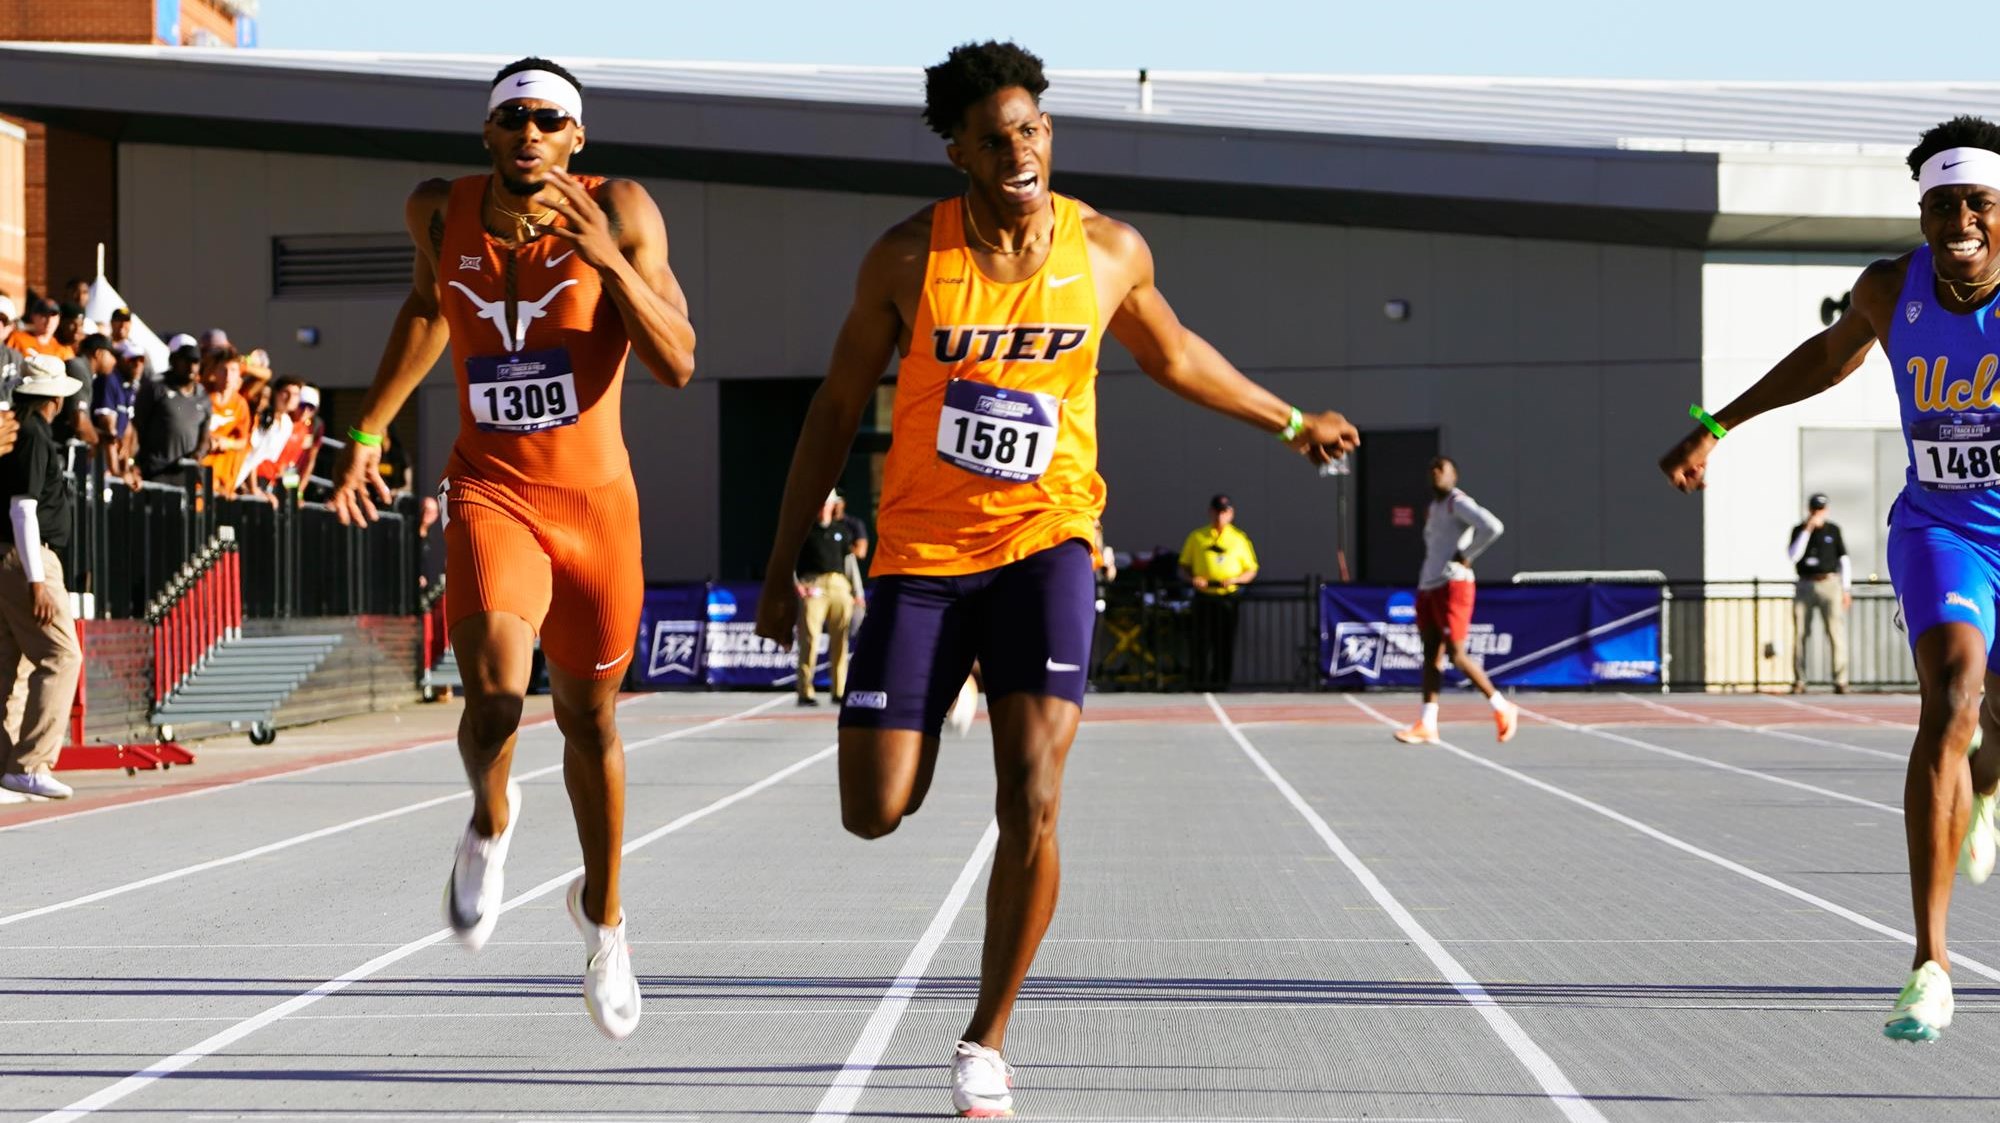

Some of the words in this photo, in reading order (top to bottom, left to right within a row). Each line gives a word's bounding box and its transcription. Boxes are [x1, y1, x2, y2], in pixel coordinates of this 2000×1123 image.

[932, 324, 1089, 363] UTEP
[484, 382, 566, 421] 1309
[954, 416, 1039, 468] 1581
